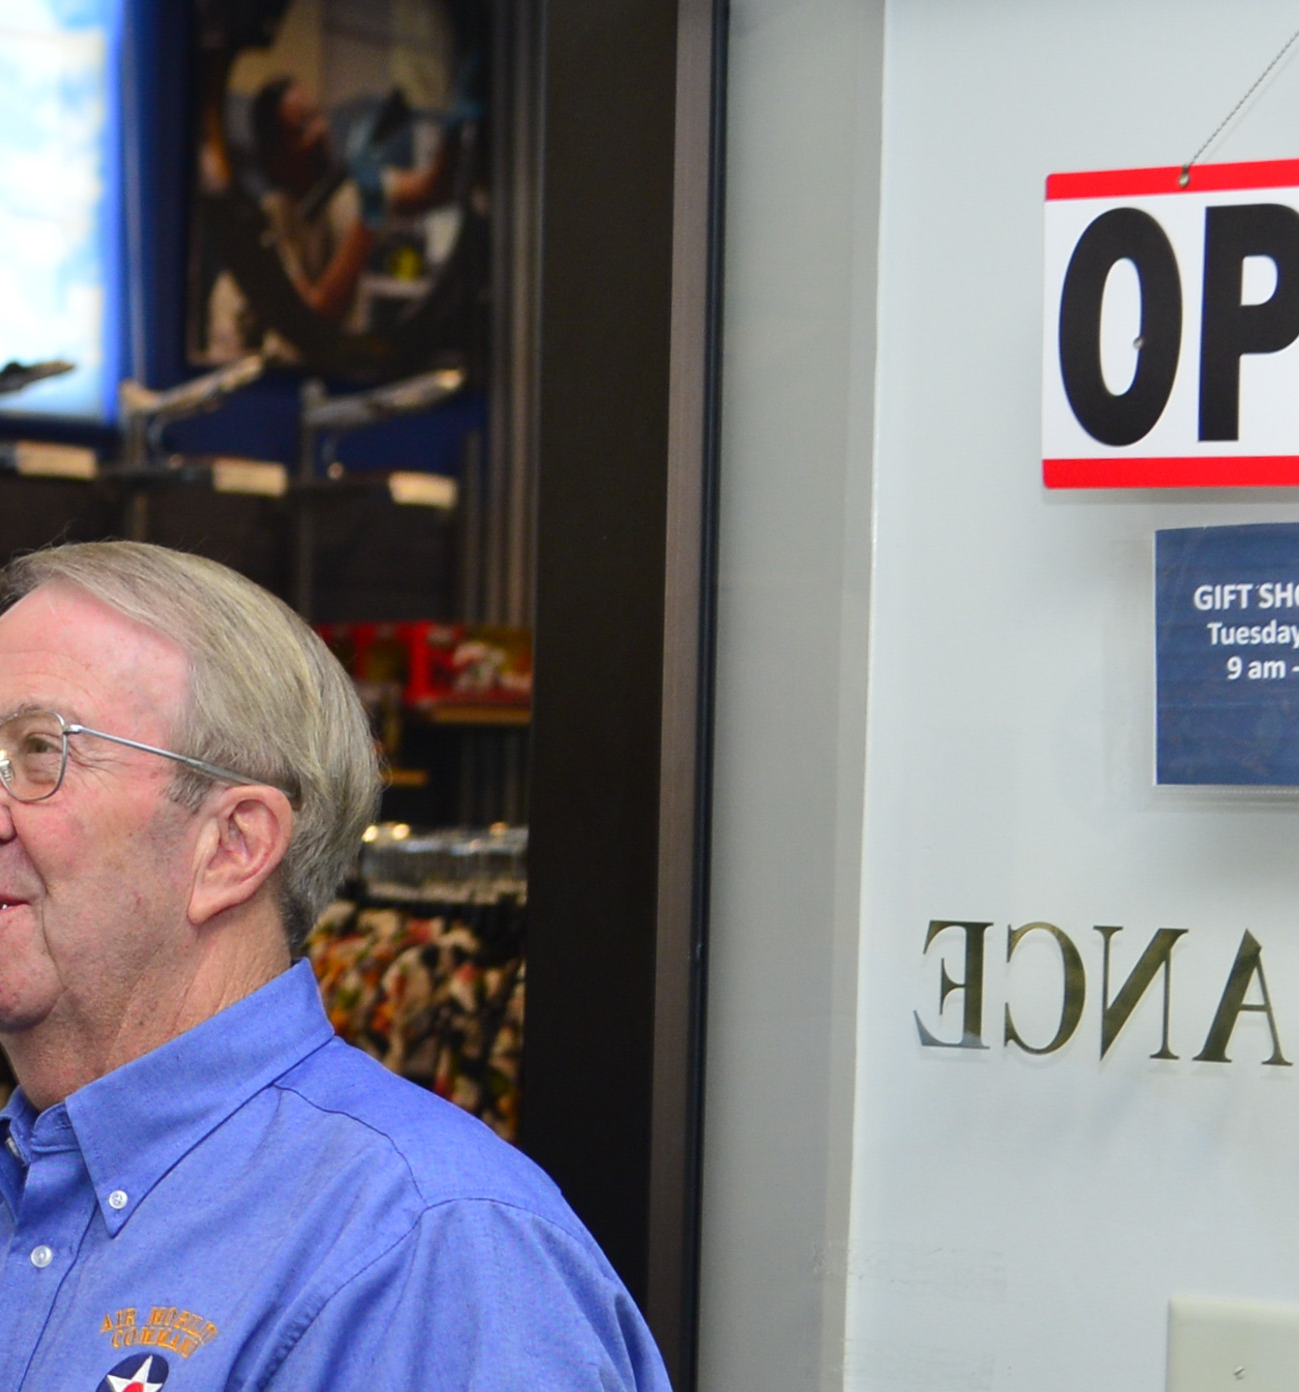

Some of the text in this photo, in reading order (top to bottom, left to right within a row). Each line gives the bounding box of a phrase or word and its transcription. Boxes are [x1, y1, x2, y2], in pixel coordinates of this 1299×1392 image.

[1058, 202, 1299, 447] OP
[1193, 582, 1299, 611] GIFT SH
[1206, 619, 1299, 649] Tuesday
[1226, 656, 1242, 680] 9
[1247, 659, 1286, 680] am
[100, 1306, 137, 1333] AIR
